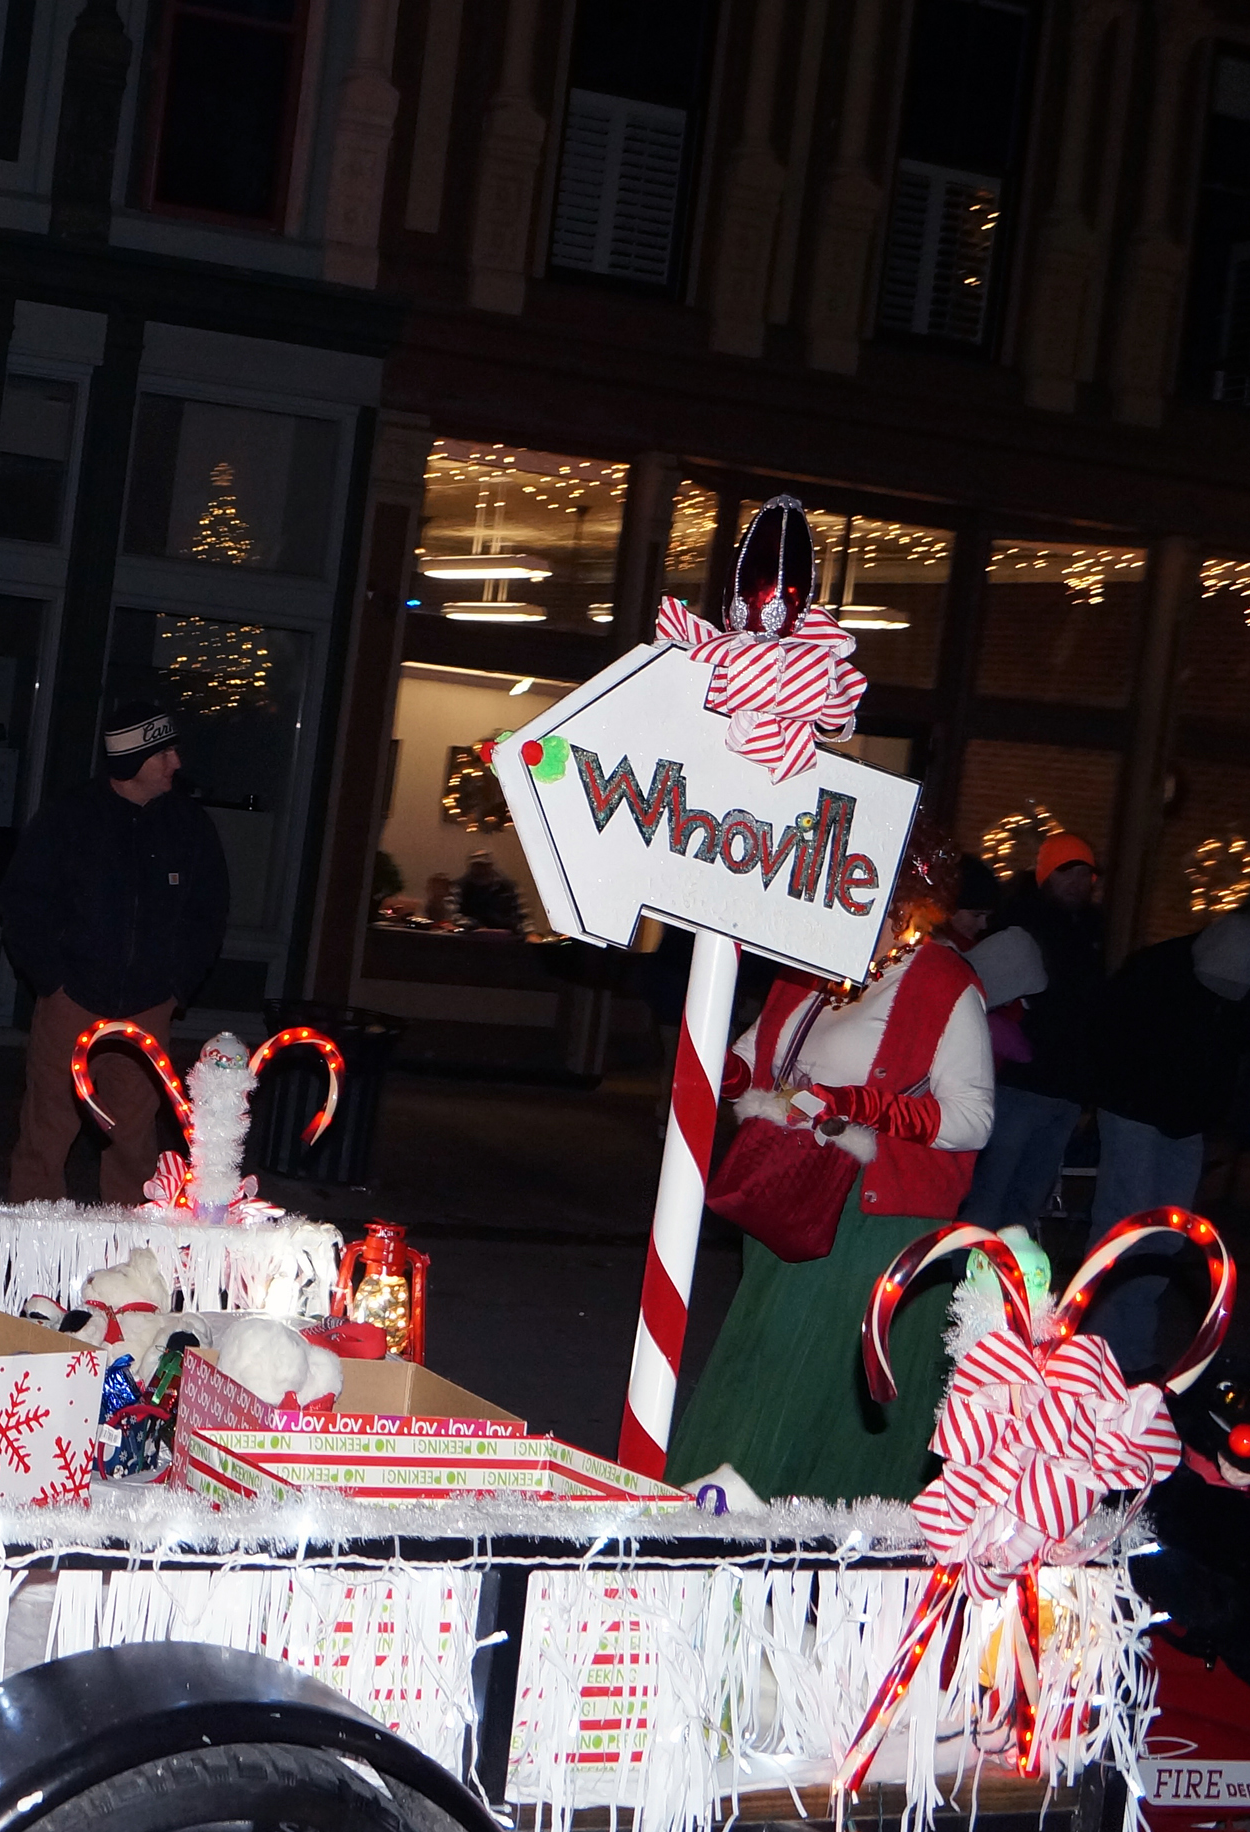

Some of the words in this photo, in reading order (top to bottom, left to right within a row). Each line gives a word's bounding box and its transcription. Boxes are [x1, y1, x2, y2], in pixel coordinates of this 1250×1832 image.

[570, 744, 880, 917] Whoville
[183, 1350, 196, 1374] Joy
[196, 1359, 210, 1384] Joy
[210, 1369, 224, 1393] Joy
[223, 1378, 238, 1403] Joy
[236, 1387, 251, 1413] Joy
[250, 1396, 264, 1424] Joy
[184, 1377, 198, 1402] Joy
[197, 1386, 211, 1412] Joy
[210, 1396, 225, 1422] Joy
[270, 1435, 291, 1450] NO
[308, 1436, 370, 1452] PEEKING!
[375, 1438, 396, 1453] NO
[413, 1439, 472, 1455] PEEKING!
[476, 1442, 497, 1456] NO
[560, 1448, 574, 1465] NO
[344, 1469, 365, 1483] NO
[382, 1469, 442, 1485] PEEKING!
[447, 1471, 467, 1485] NO
[582, 1456, 622, 1484] PEEKING!
[482, 1471, 543, 1487] PEEKING!
[624, 1473, 639, 1491] NO
[580, 1735, 603, 1750] NO
[1153, 1769, 1223, 1799] FIRE
